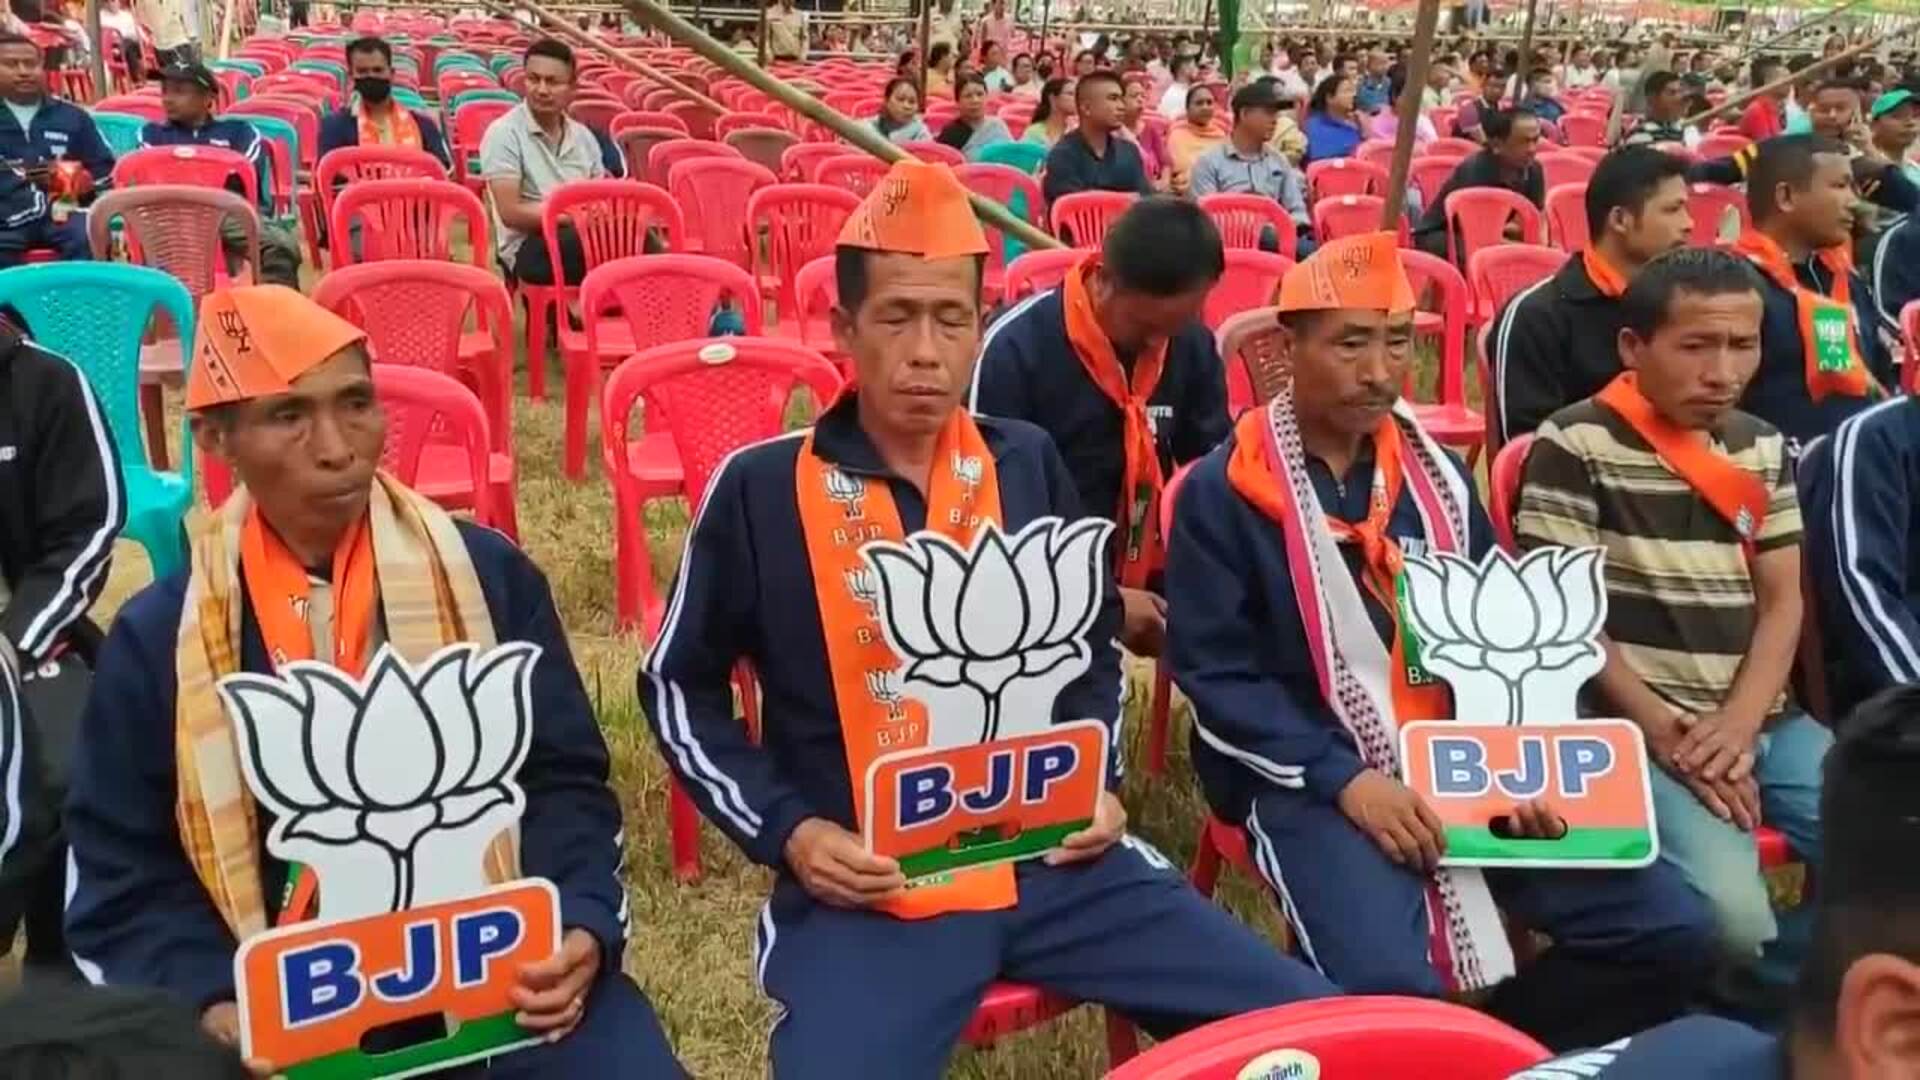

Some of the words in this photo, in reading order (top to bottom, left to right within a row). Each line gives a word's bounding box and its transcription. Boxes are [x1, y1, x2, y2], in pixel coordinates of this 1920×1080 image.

[895, 741, 1080, 830] BJP
[1428, 736, 1616, 799] BJP
[277, 906, 526, 1030] BJP
